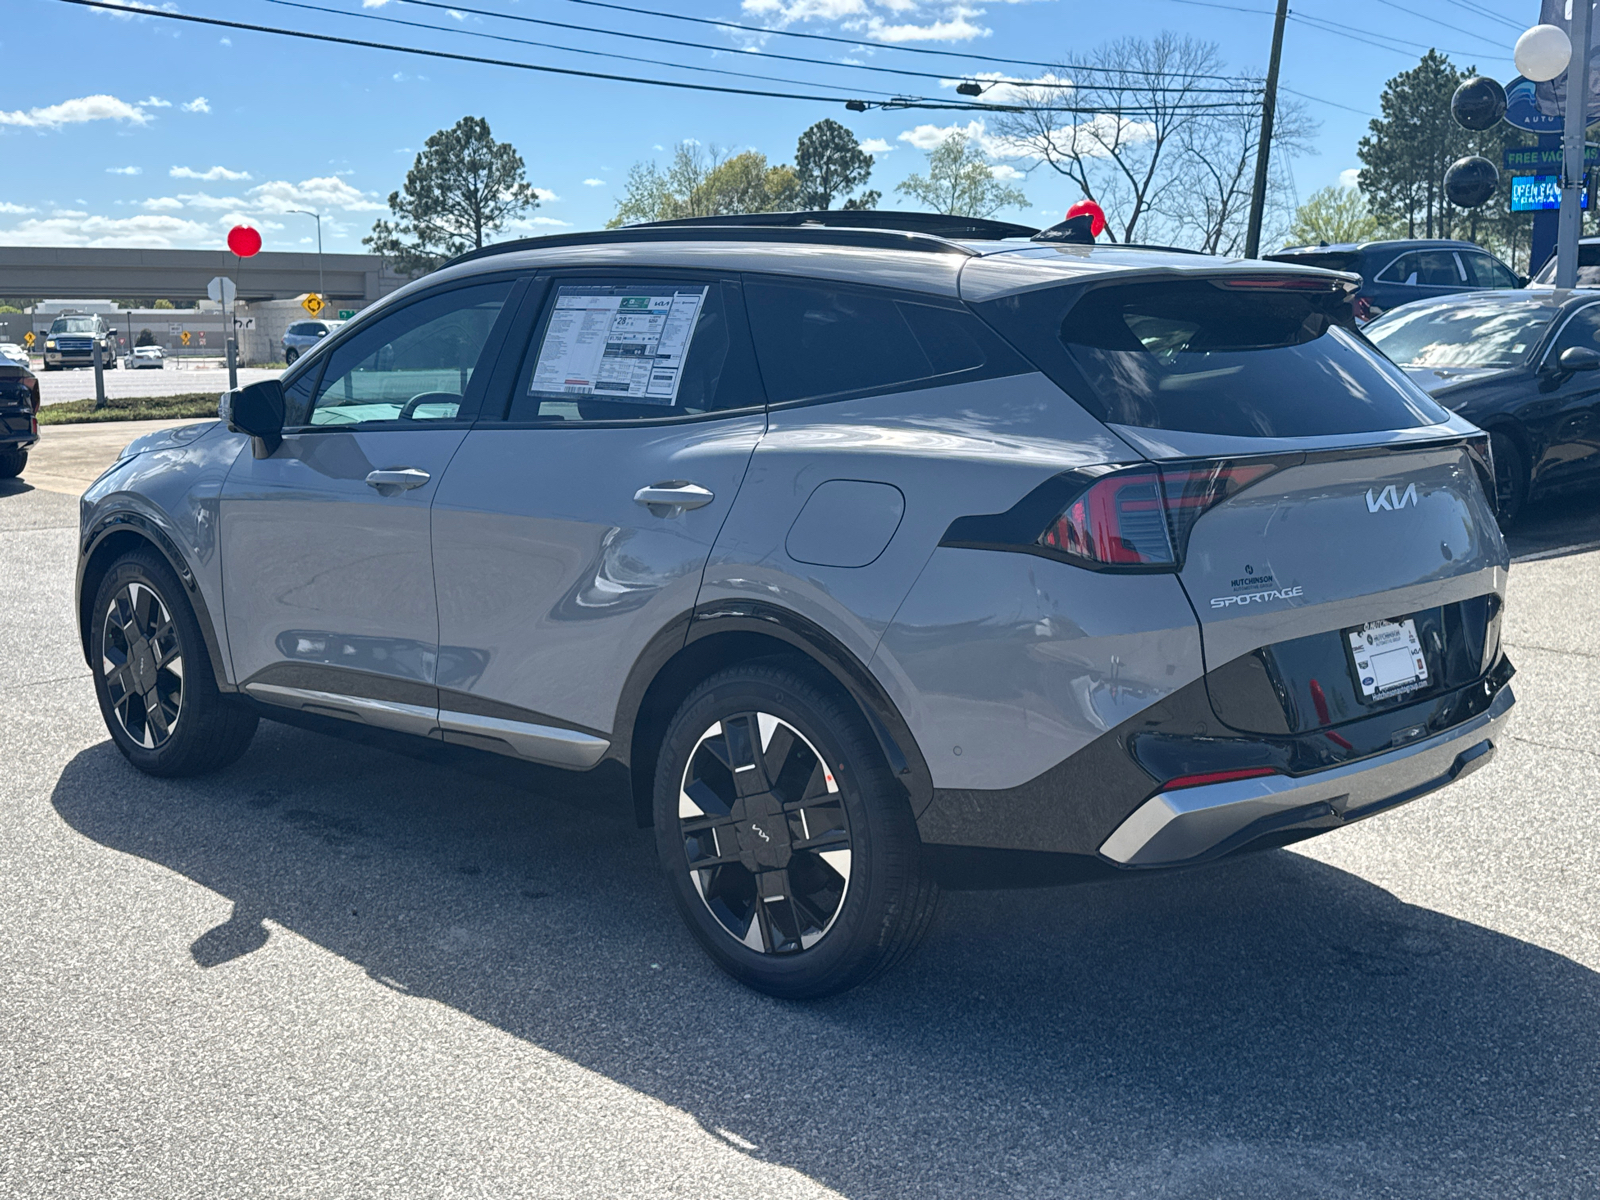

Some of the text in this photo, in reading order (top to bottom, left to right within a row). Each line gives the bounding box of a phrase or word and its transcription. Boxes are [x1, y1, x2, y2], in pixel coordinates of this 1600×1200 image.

[1524, 115, 1554, 123] AUTO
[1508, 148, 1598, 165] FREE VACMS
[1513, 183, 1538, 198] OPEN
[617, 316, 627, 325] 28
[1365, 482, 1418, 513] KIA
[1230, 575, 1273, 587] HUTCHINSON
[1233, 582, 1273, 592] AUTOMOTIVE GROUP
[1210, 586, 1304, 609] SPORTAGE
